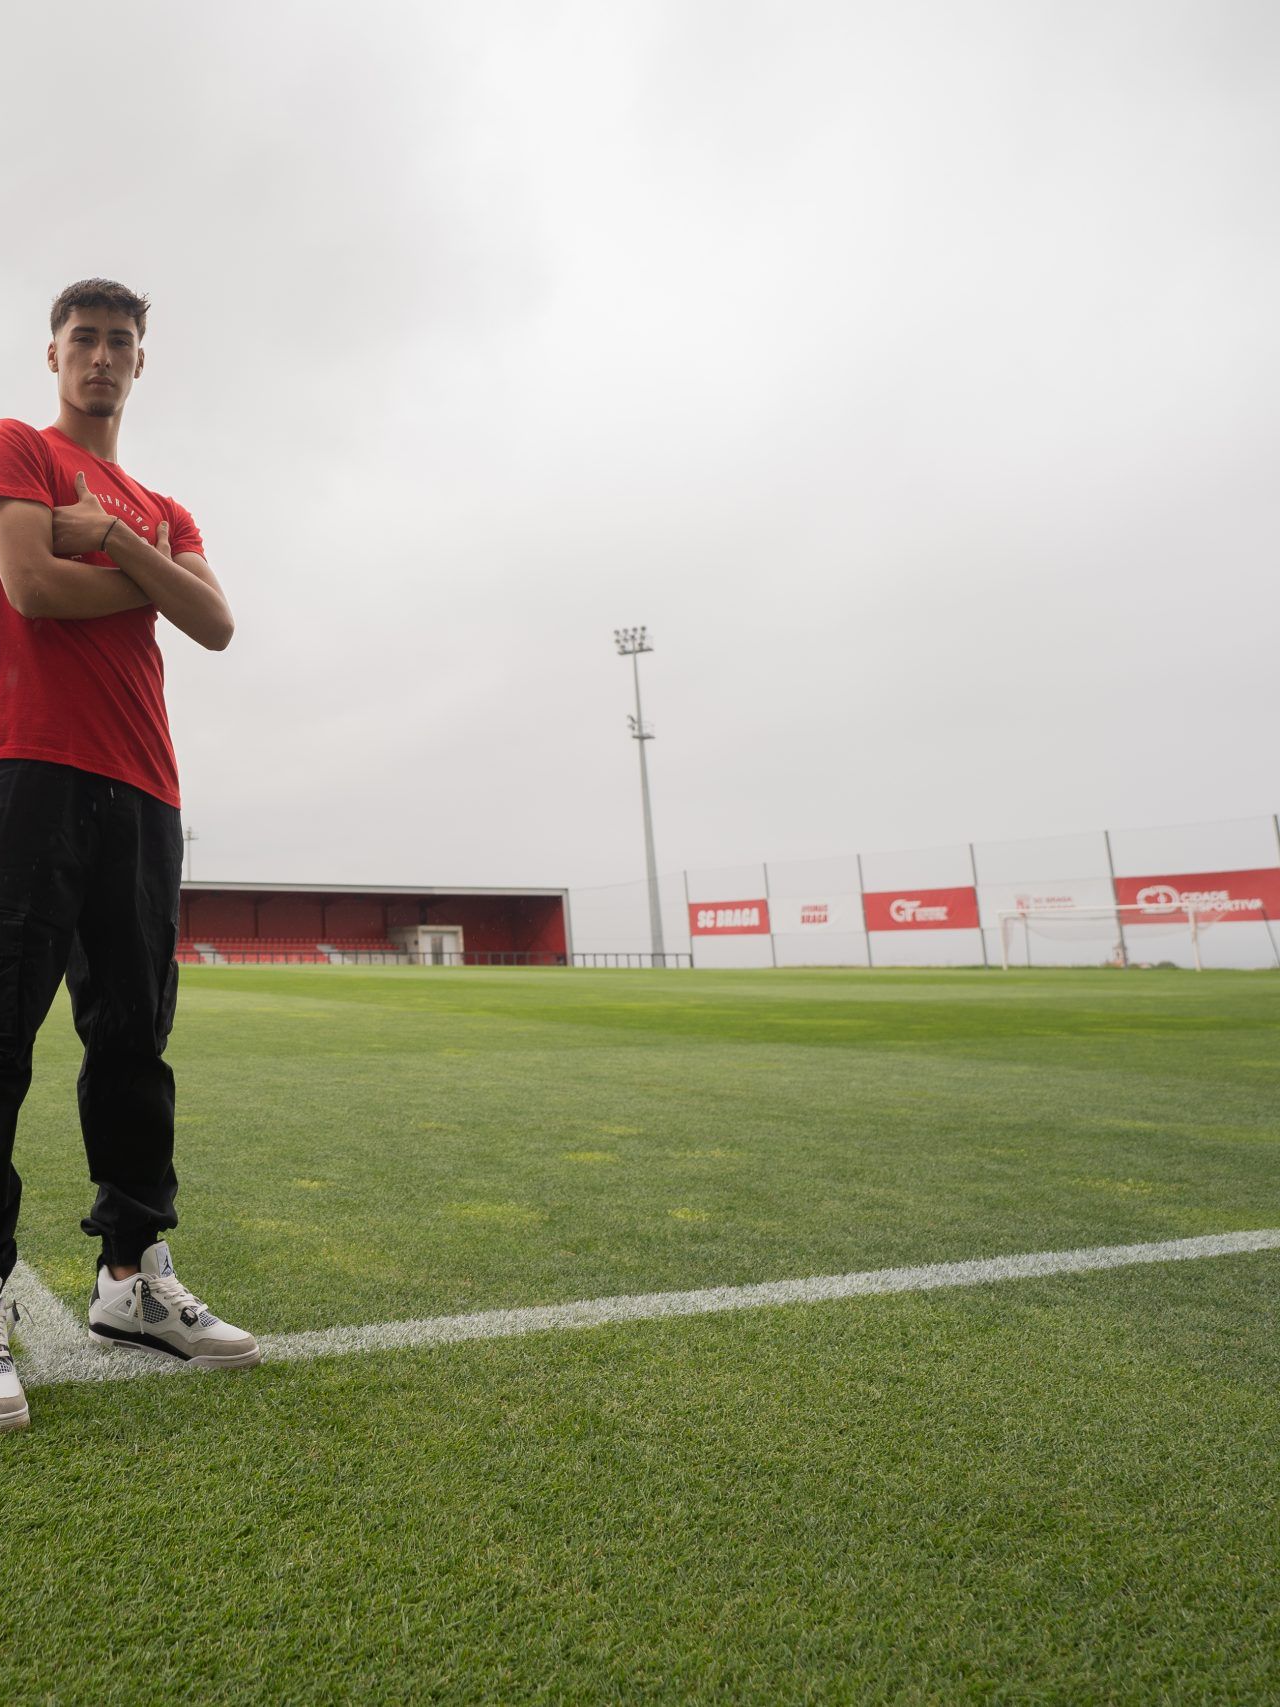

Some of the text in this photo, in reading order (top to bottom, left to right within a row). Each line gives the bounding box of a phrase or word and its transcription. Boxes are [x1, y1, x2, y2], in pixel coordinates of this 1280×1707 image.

[99, 493, 150, 531] ERREIRO
[1180, 890, 1229, 903] CIDADE
[697, 907, 760, 929] SC BRAGA
